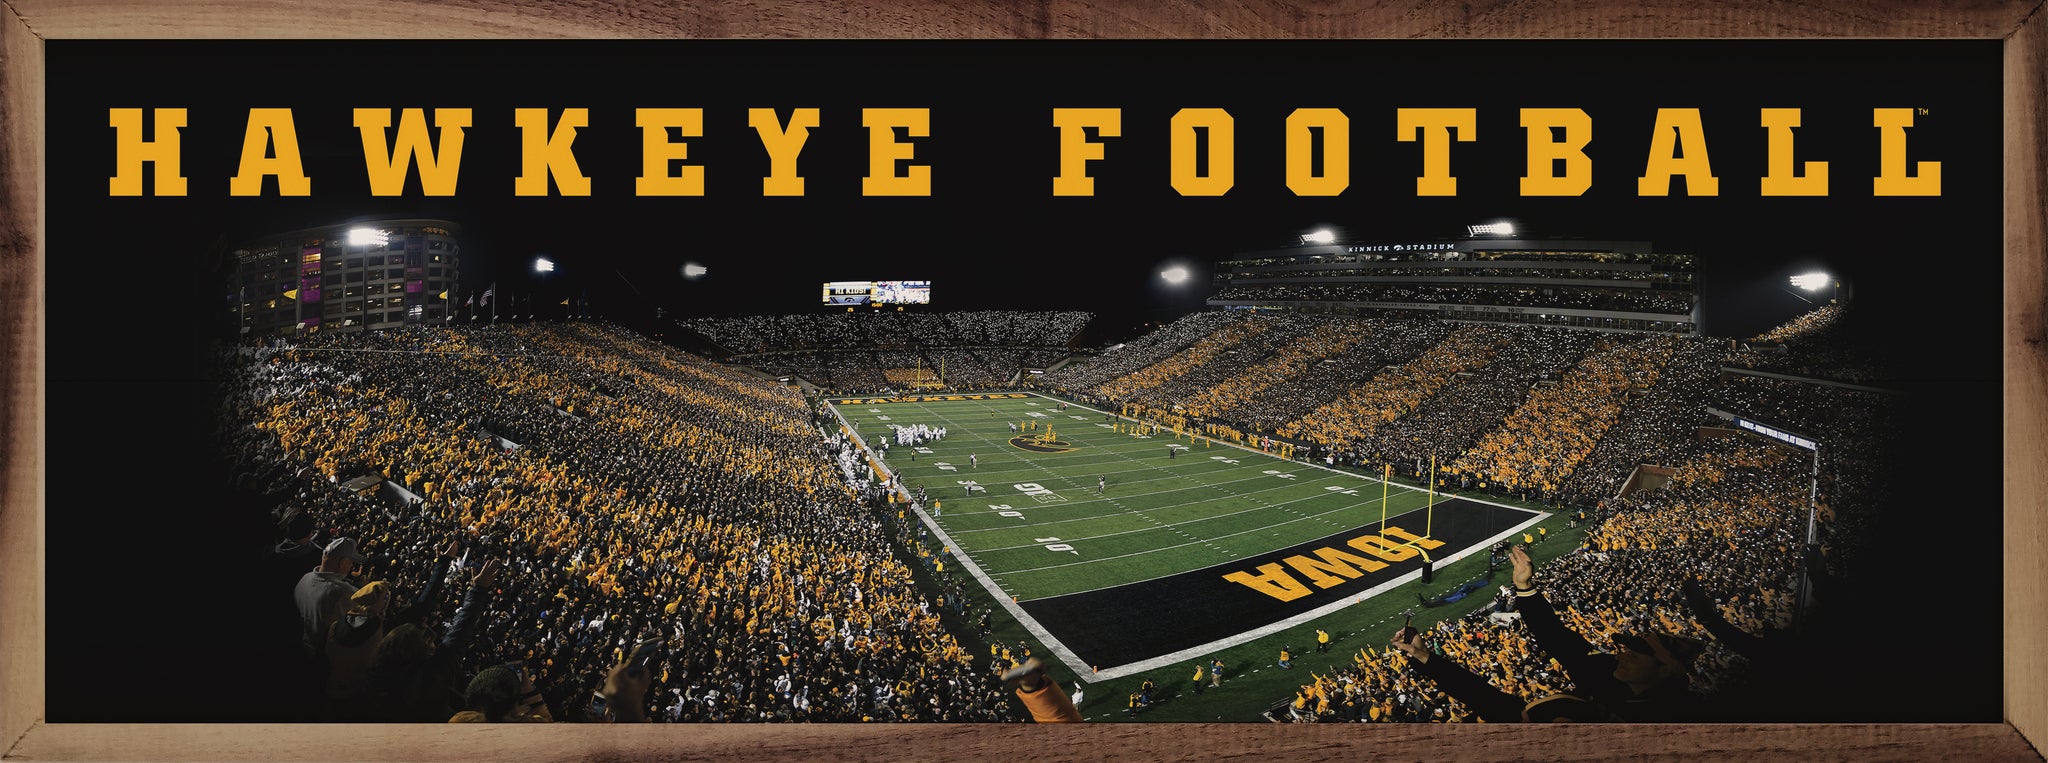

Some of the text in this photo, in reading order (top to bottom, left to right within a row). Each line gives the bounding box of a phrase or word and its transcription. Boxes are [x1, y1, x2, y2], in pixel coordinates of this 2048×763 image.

[110, 108, 931, 196] HAWKEYE
[1053, 108, 1941, 196] FOOTBALL
[1348, 243, 1455, 253] KINNICK STADIUM
[1035, 537, 1074, 552] 10
[1221, 526, 1446, 602] IOWA
